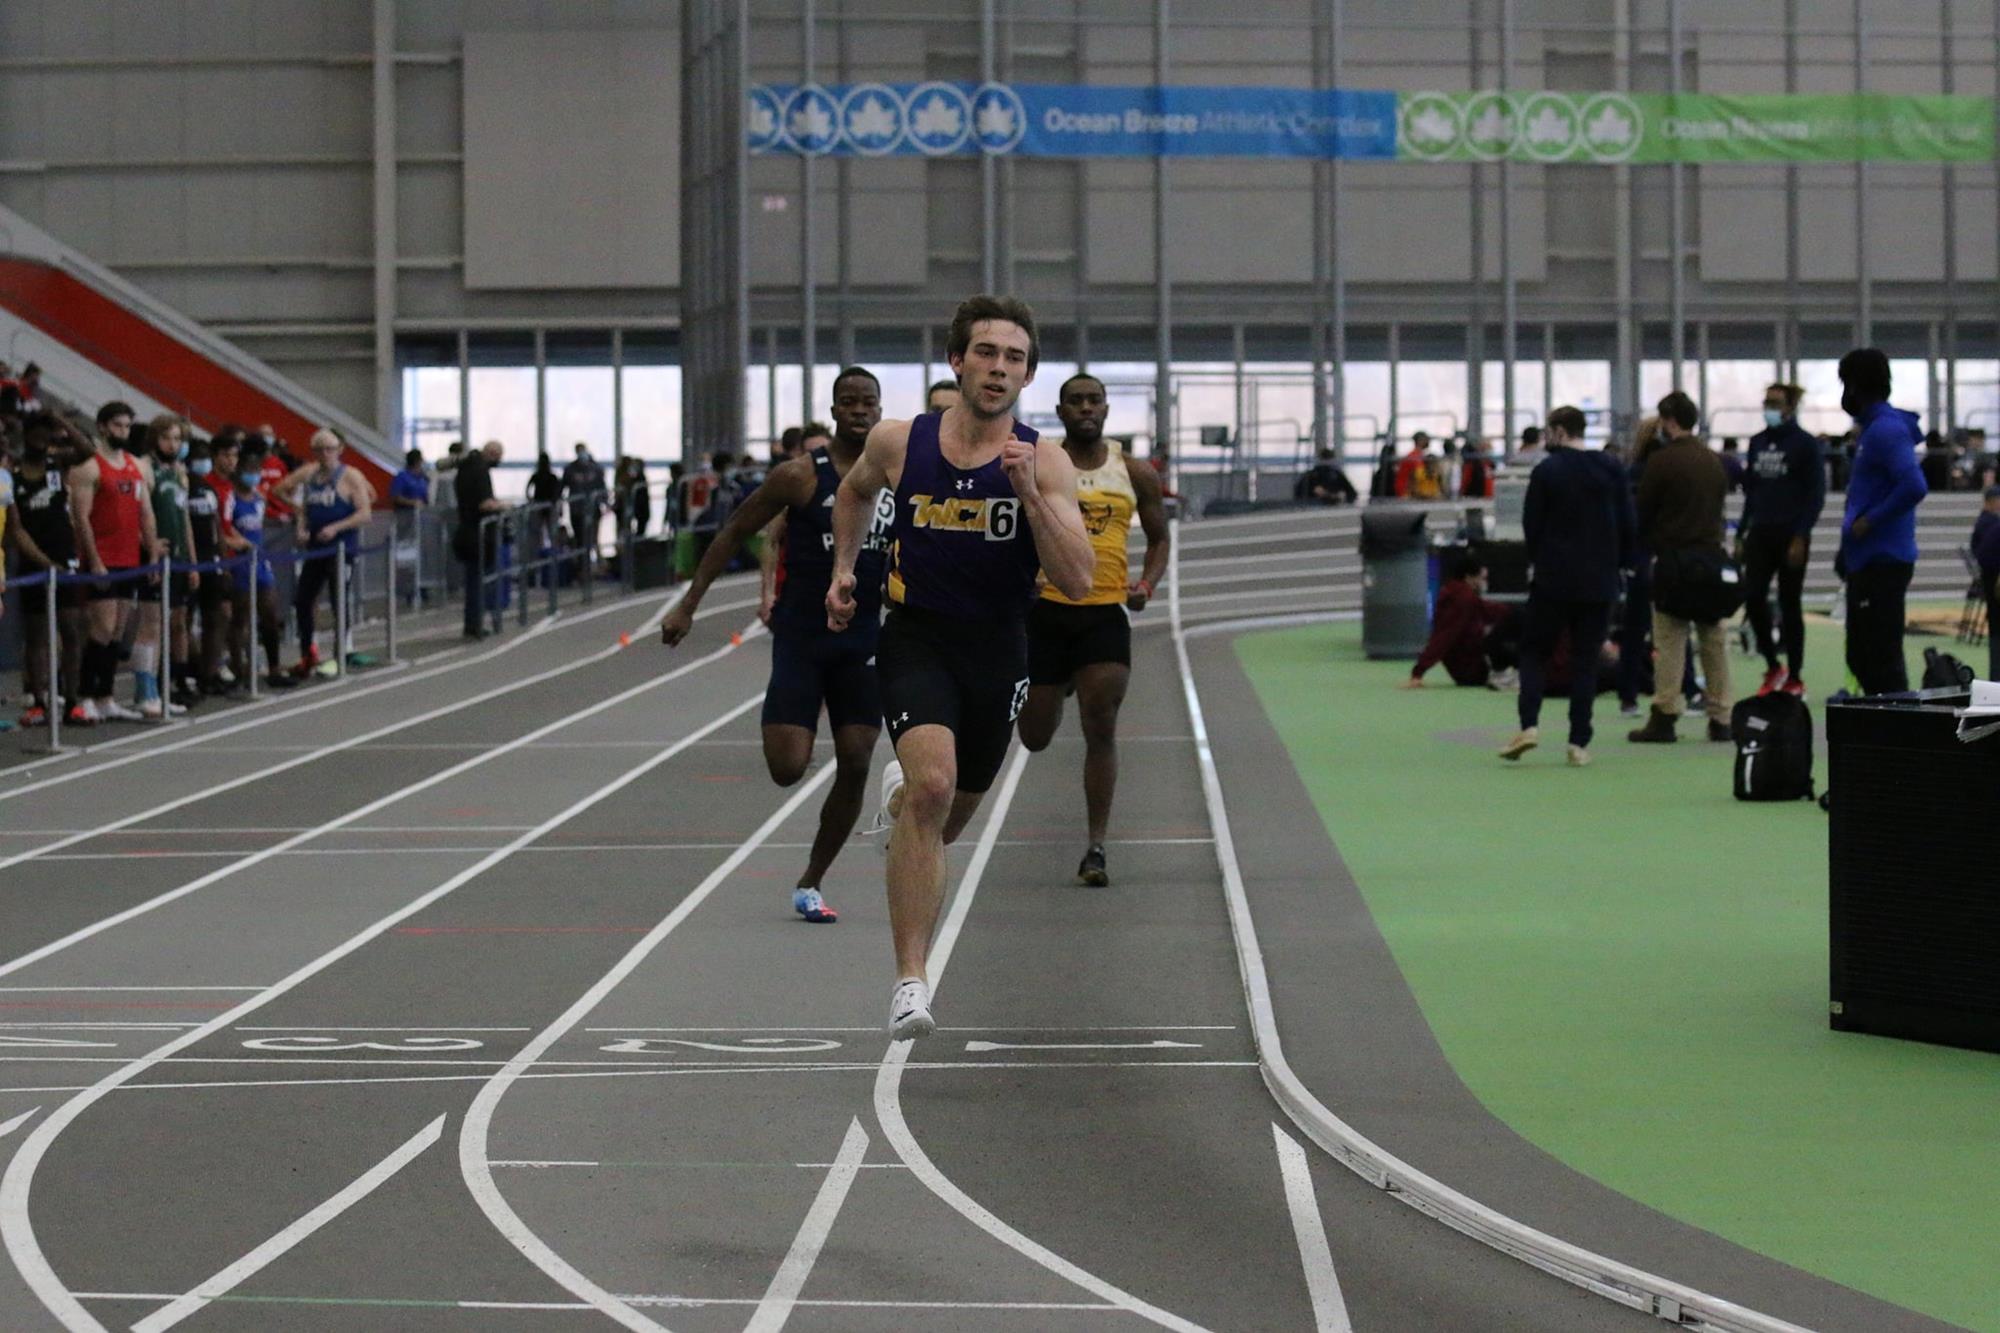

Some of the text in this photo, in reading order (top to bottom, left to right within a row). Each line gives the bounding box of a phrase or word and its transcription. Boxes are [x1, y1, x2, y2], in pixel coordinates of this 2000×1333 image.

[1043, 106, 1121, 135] Ocean
[990, 500, 1014, 538] 6
[242, 1036, 484, 1051] 3
[598, 1038, 842, 1053] 2
[964, 1040, 1203, 1051] 1
